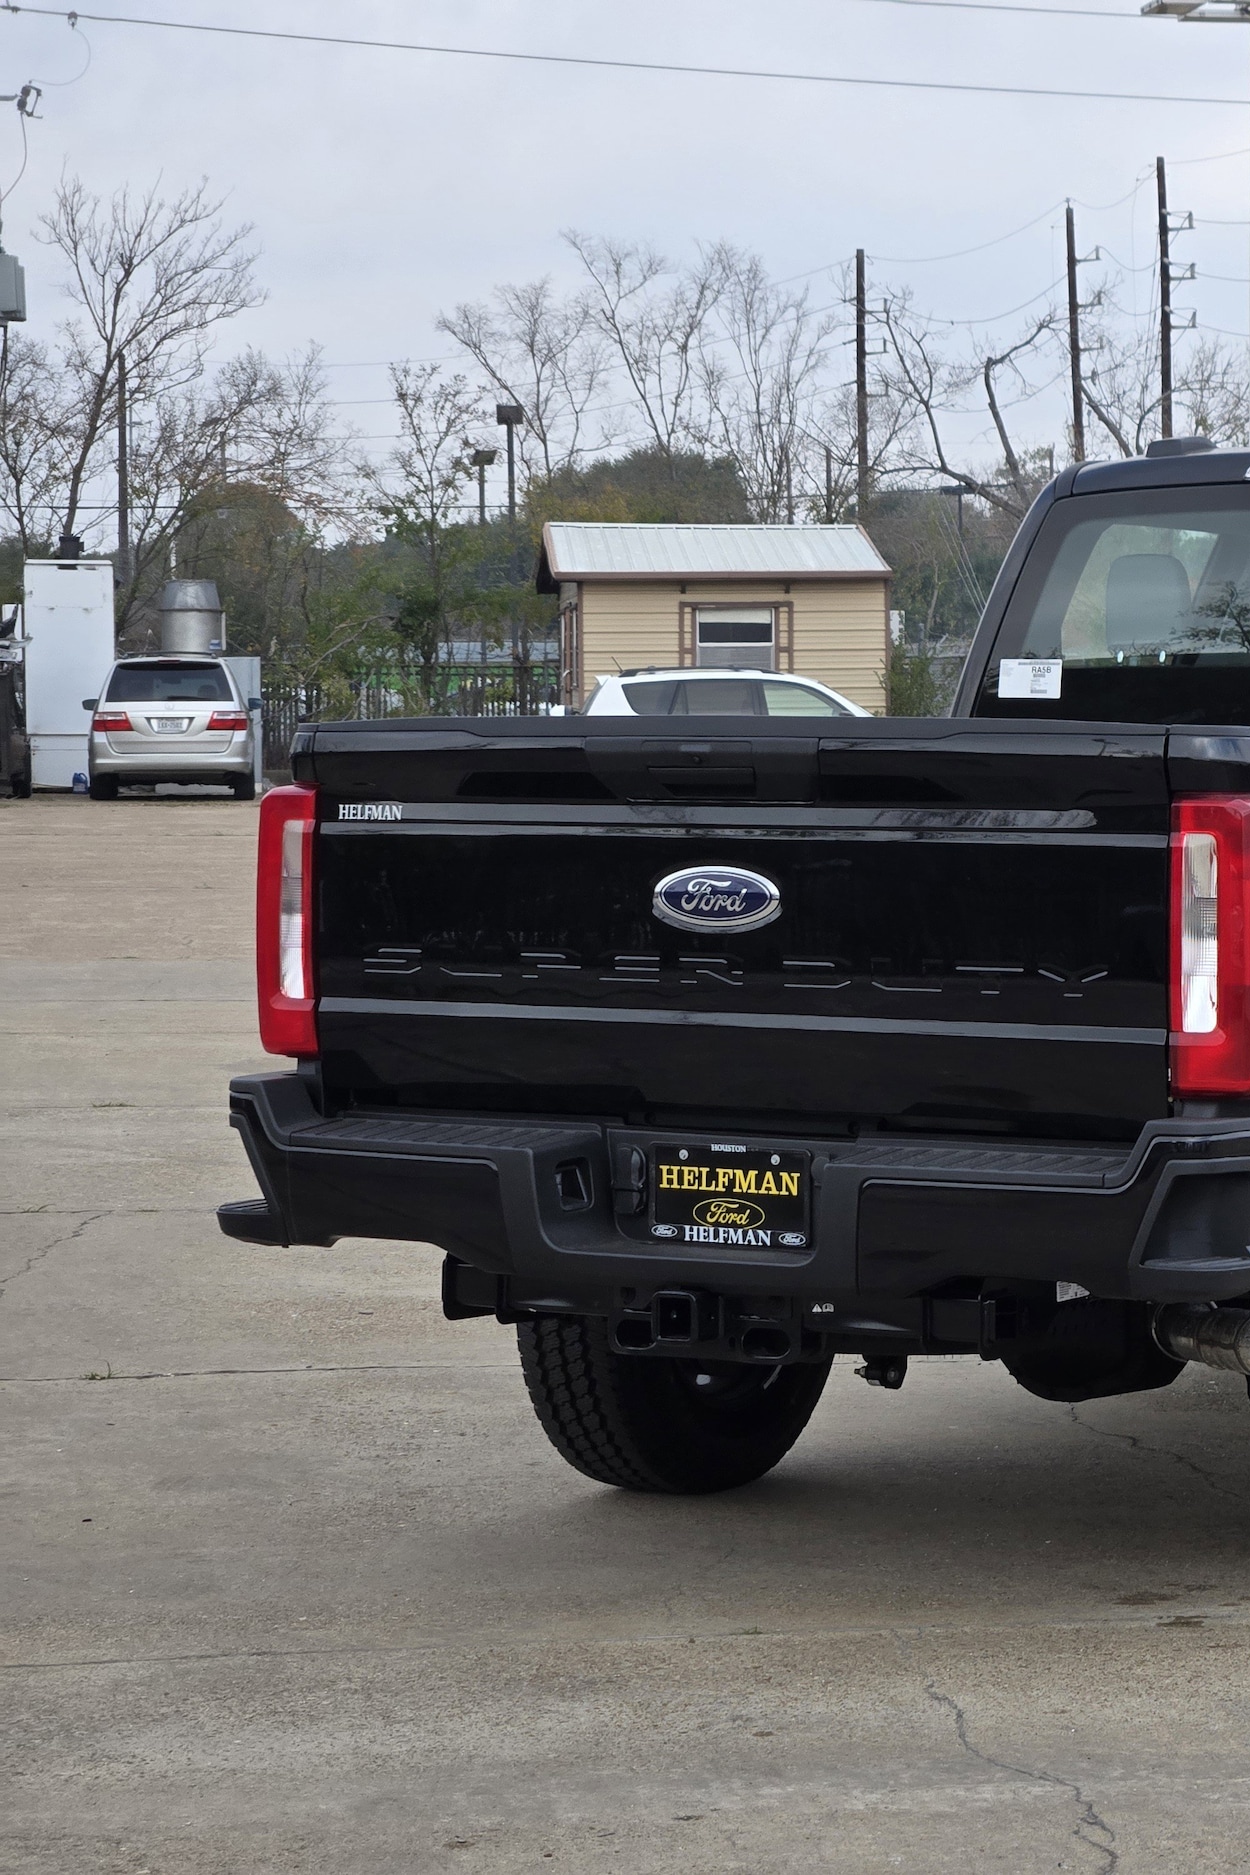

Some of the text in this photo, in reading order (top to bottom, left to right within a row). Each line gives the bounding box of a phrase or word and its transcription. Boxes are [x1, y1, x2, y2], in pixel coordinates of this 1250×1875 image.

[338, 804, 403, 820] HELFMAN
[681, 878, 748, 912] Ford
[362, 946, 1109, 997] SUPER DUTY
[711, 1143, 747, 1153] HOUSTON
[659, 1164, 801, 1197] HELFMAN
[706, 1202, 750, 1226] Ford
[684, 1225, 772, 1247] HELFMAN
